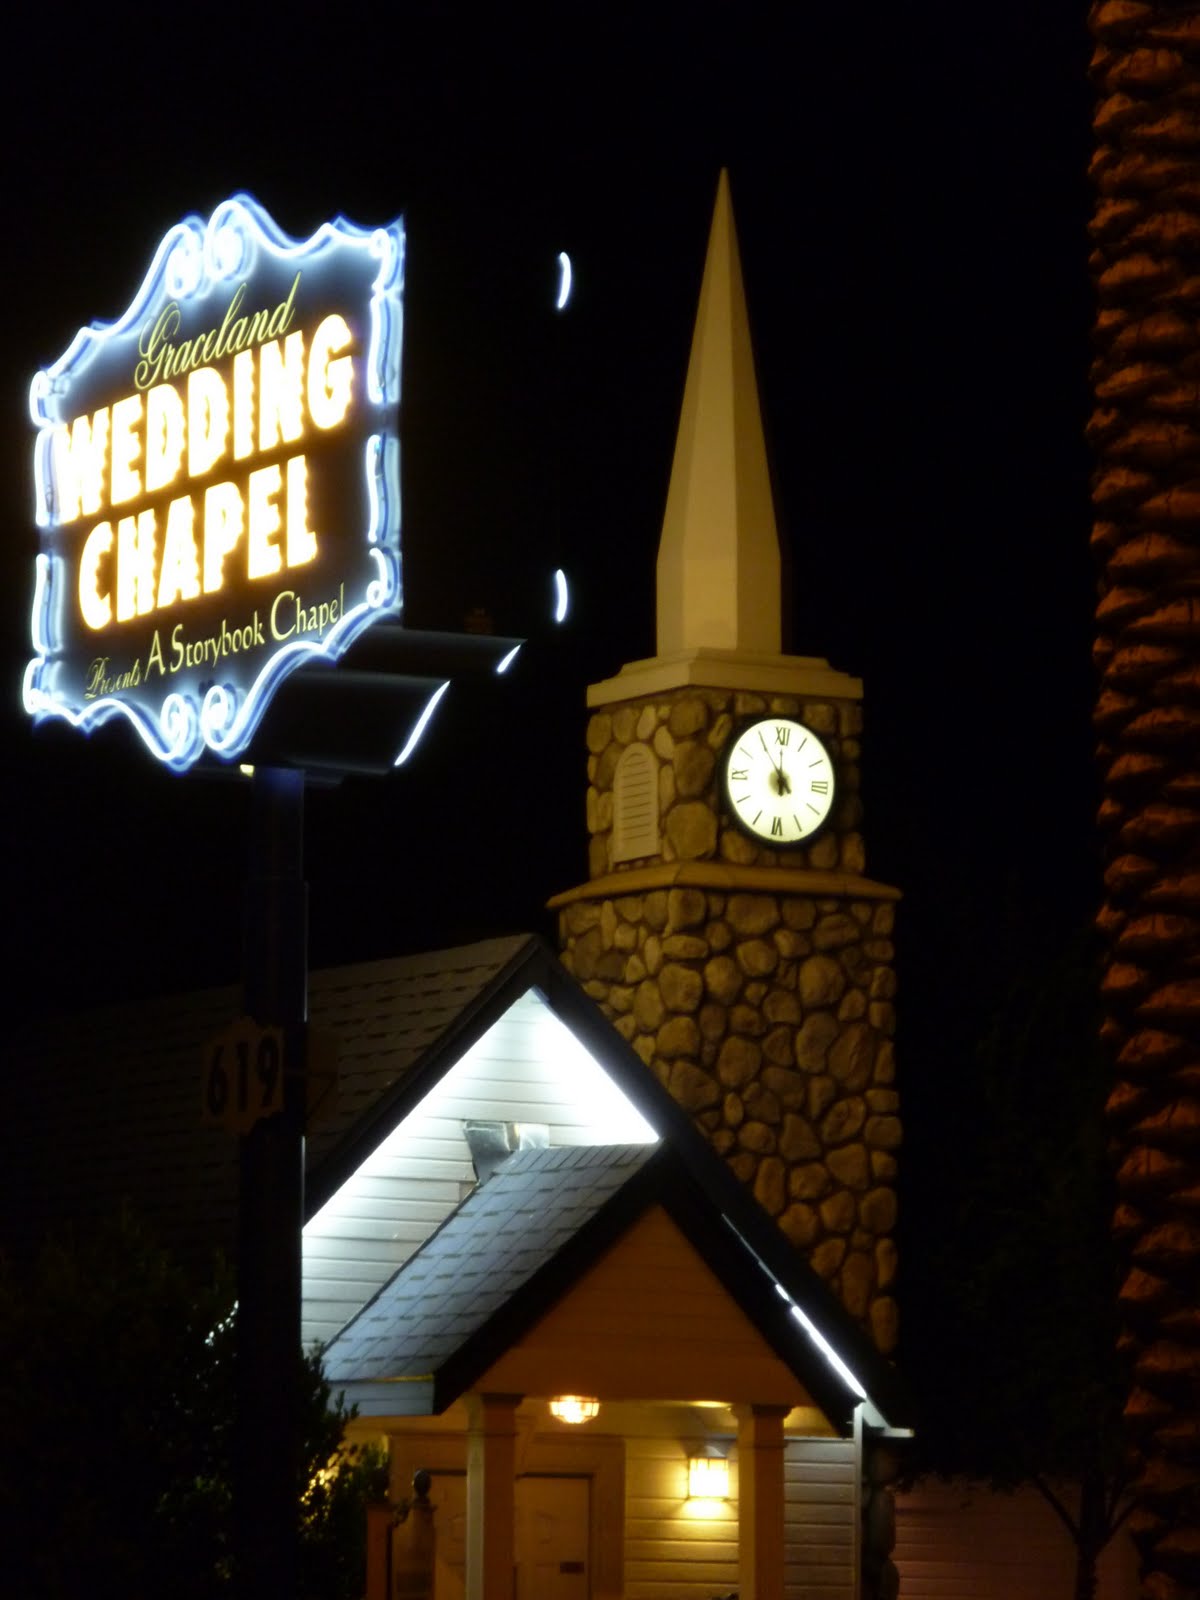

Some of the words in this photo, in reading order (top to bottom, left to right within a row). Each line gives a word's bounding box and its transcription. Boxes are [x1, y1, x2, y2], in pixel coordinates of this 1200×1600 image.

[134, 271, 301, 390] Graceland
[54, 313, 354, 525] WEDDING
[78, 455, 318, 631] CHAPEL
[144, 629, 166, 682] A
[170, 611, 265, 673] Storybook
[270, 582, 345, 641] Chapel
[207, 1036, 279, 1116] 619
